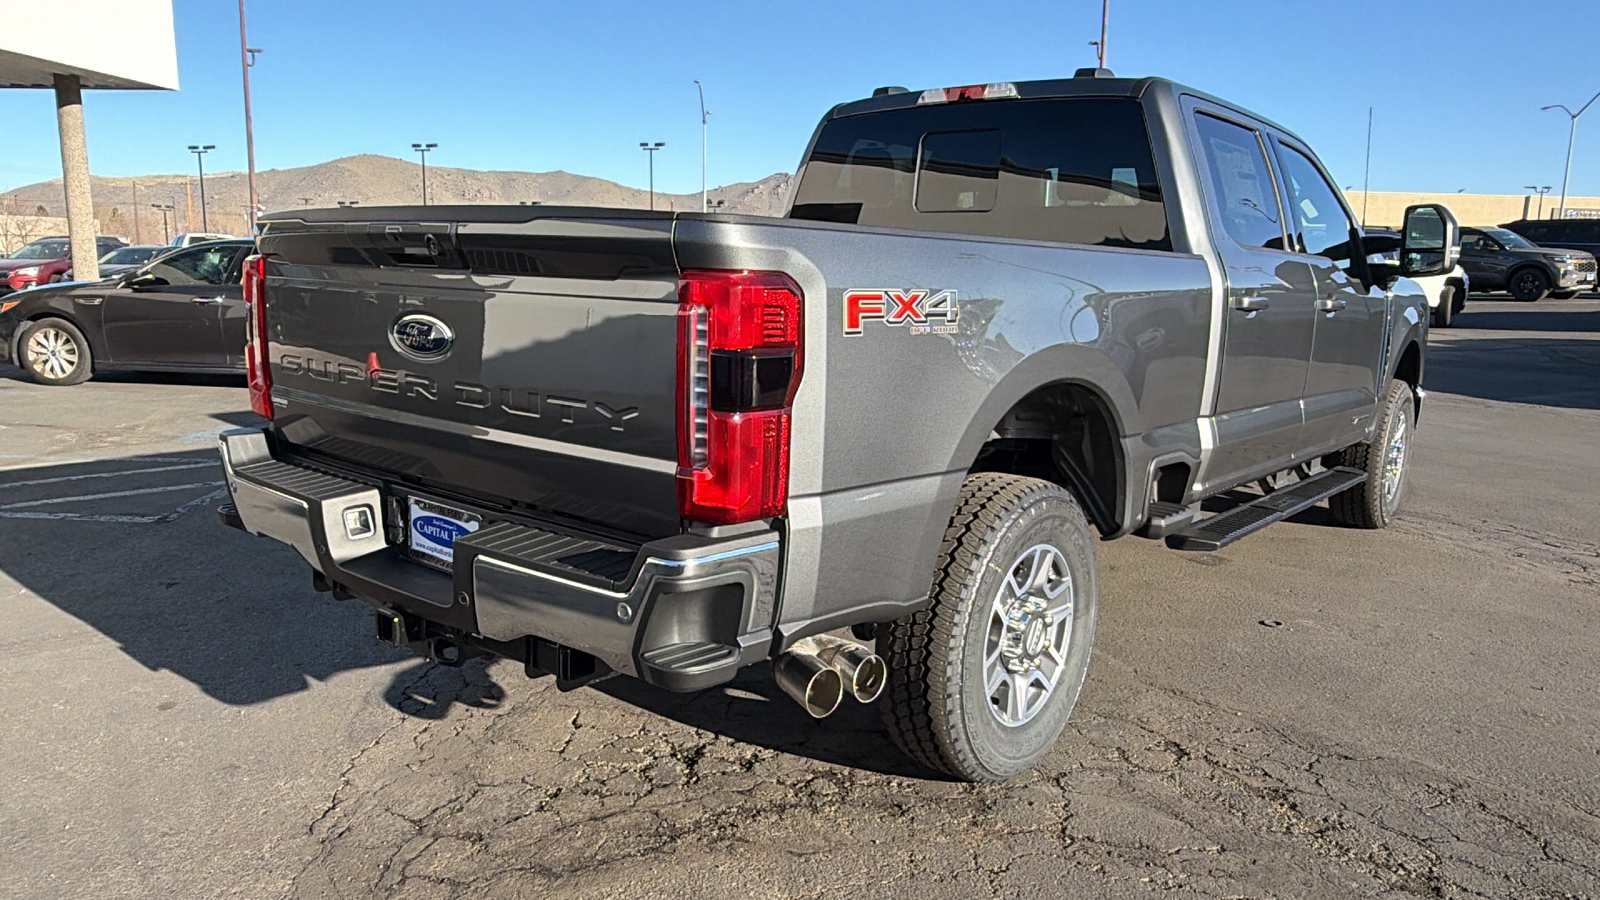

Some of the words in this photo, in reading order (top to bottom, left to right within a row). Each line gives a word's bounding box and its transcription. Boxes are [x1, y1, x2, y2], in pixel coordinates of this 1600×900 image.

[843, 288, 959, 337] FX4
[403, 322, 436, 348] Ford
[279, 353, 438, 401] SUPER
[454, 381, 640, 431] DUTY
[416, 520, 450, 541] CAPITAL
